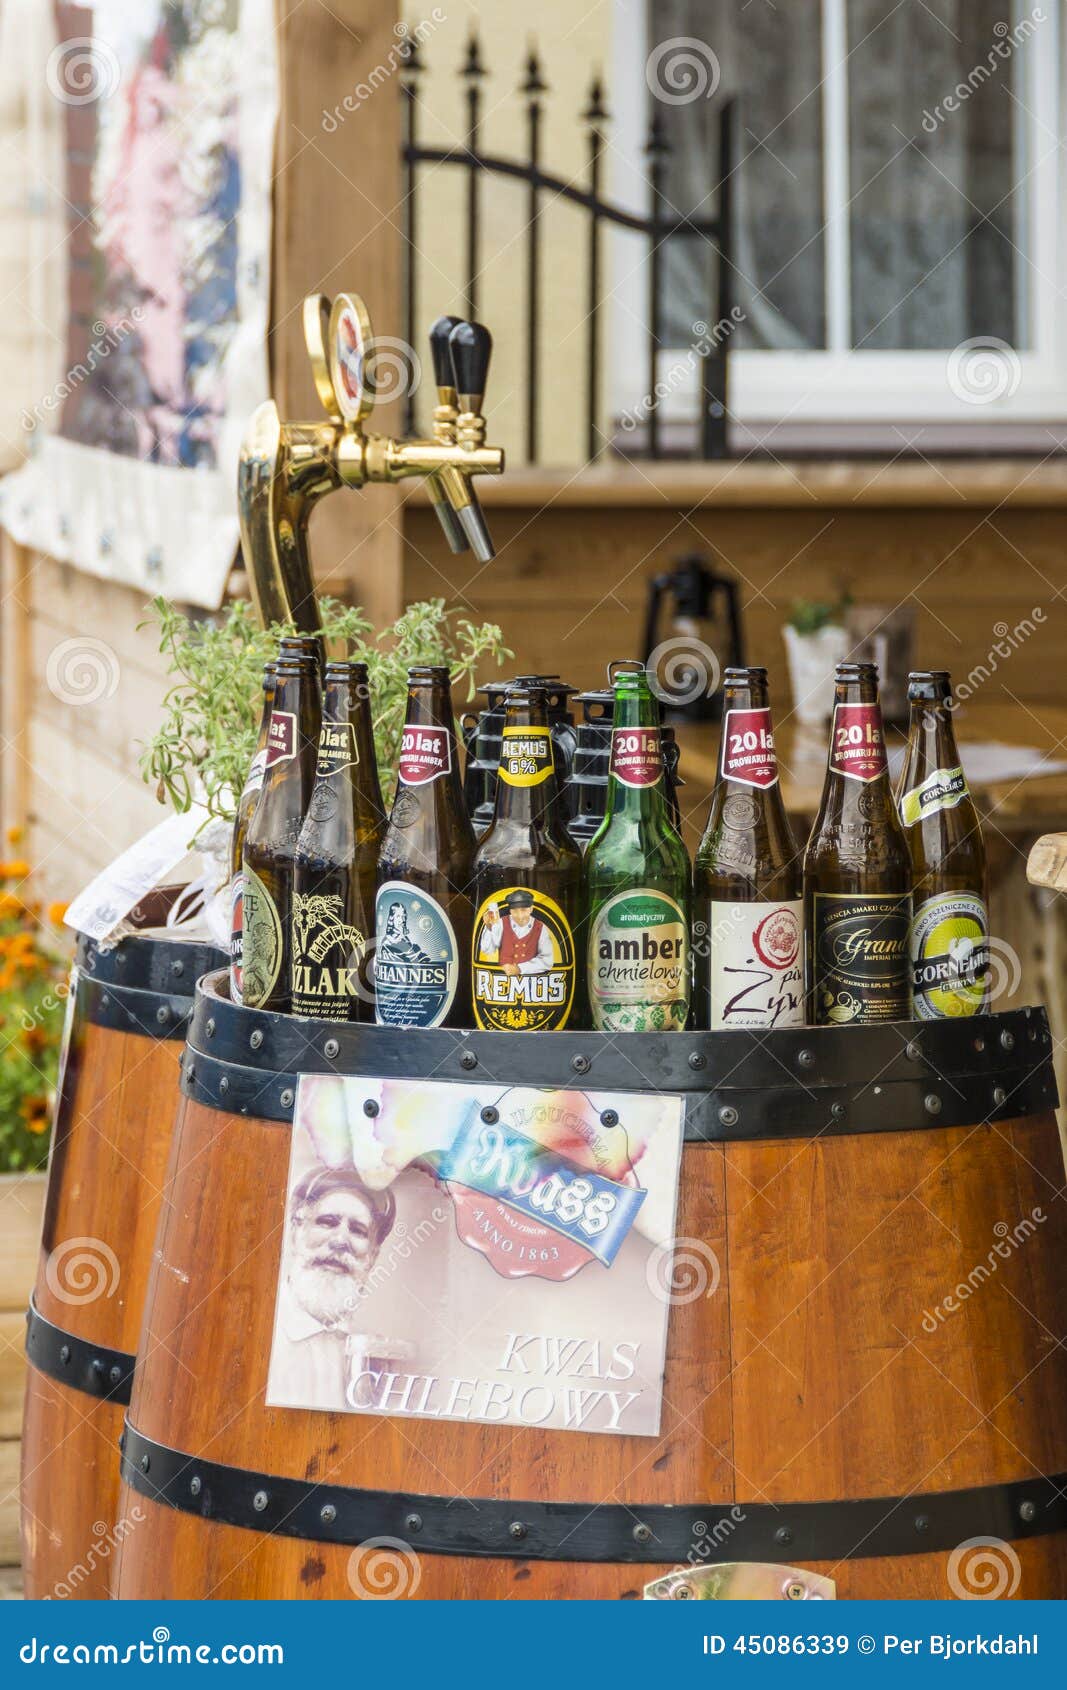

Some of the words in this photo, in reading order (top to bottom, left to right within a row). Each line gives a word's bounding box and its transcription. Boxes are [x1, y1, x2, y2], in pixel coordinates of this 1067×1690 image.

[326, 729, 349, 748] lat
[416, 733, 441, 754] lat
[616, 736, 639, 754] 20
[730, 731, 757, 753] 20
[836, 725, 863, 747] 20
[503, 741, 548, 757] REMUS
[834, 749, 871, 761] BROWARU
[728, 754, 766, 768] BROWARU
[620, 913, 665, 922] aromatyczny
[852, 905, 878, 914] SMAKU
[599, 933, 683, 960] amber
[598, 961, 682, 989] chmielowy
[477, 969, 566, 1004] REMUS
[472, 1208, 513, 1252] ANNO
[519, 1246, 559, 1261] 1863
[495, 1332, 639, 1382] KWAS
[346, 1369, 640, 1430] CHLEBOWY
